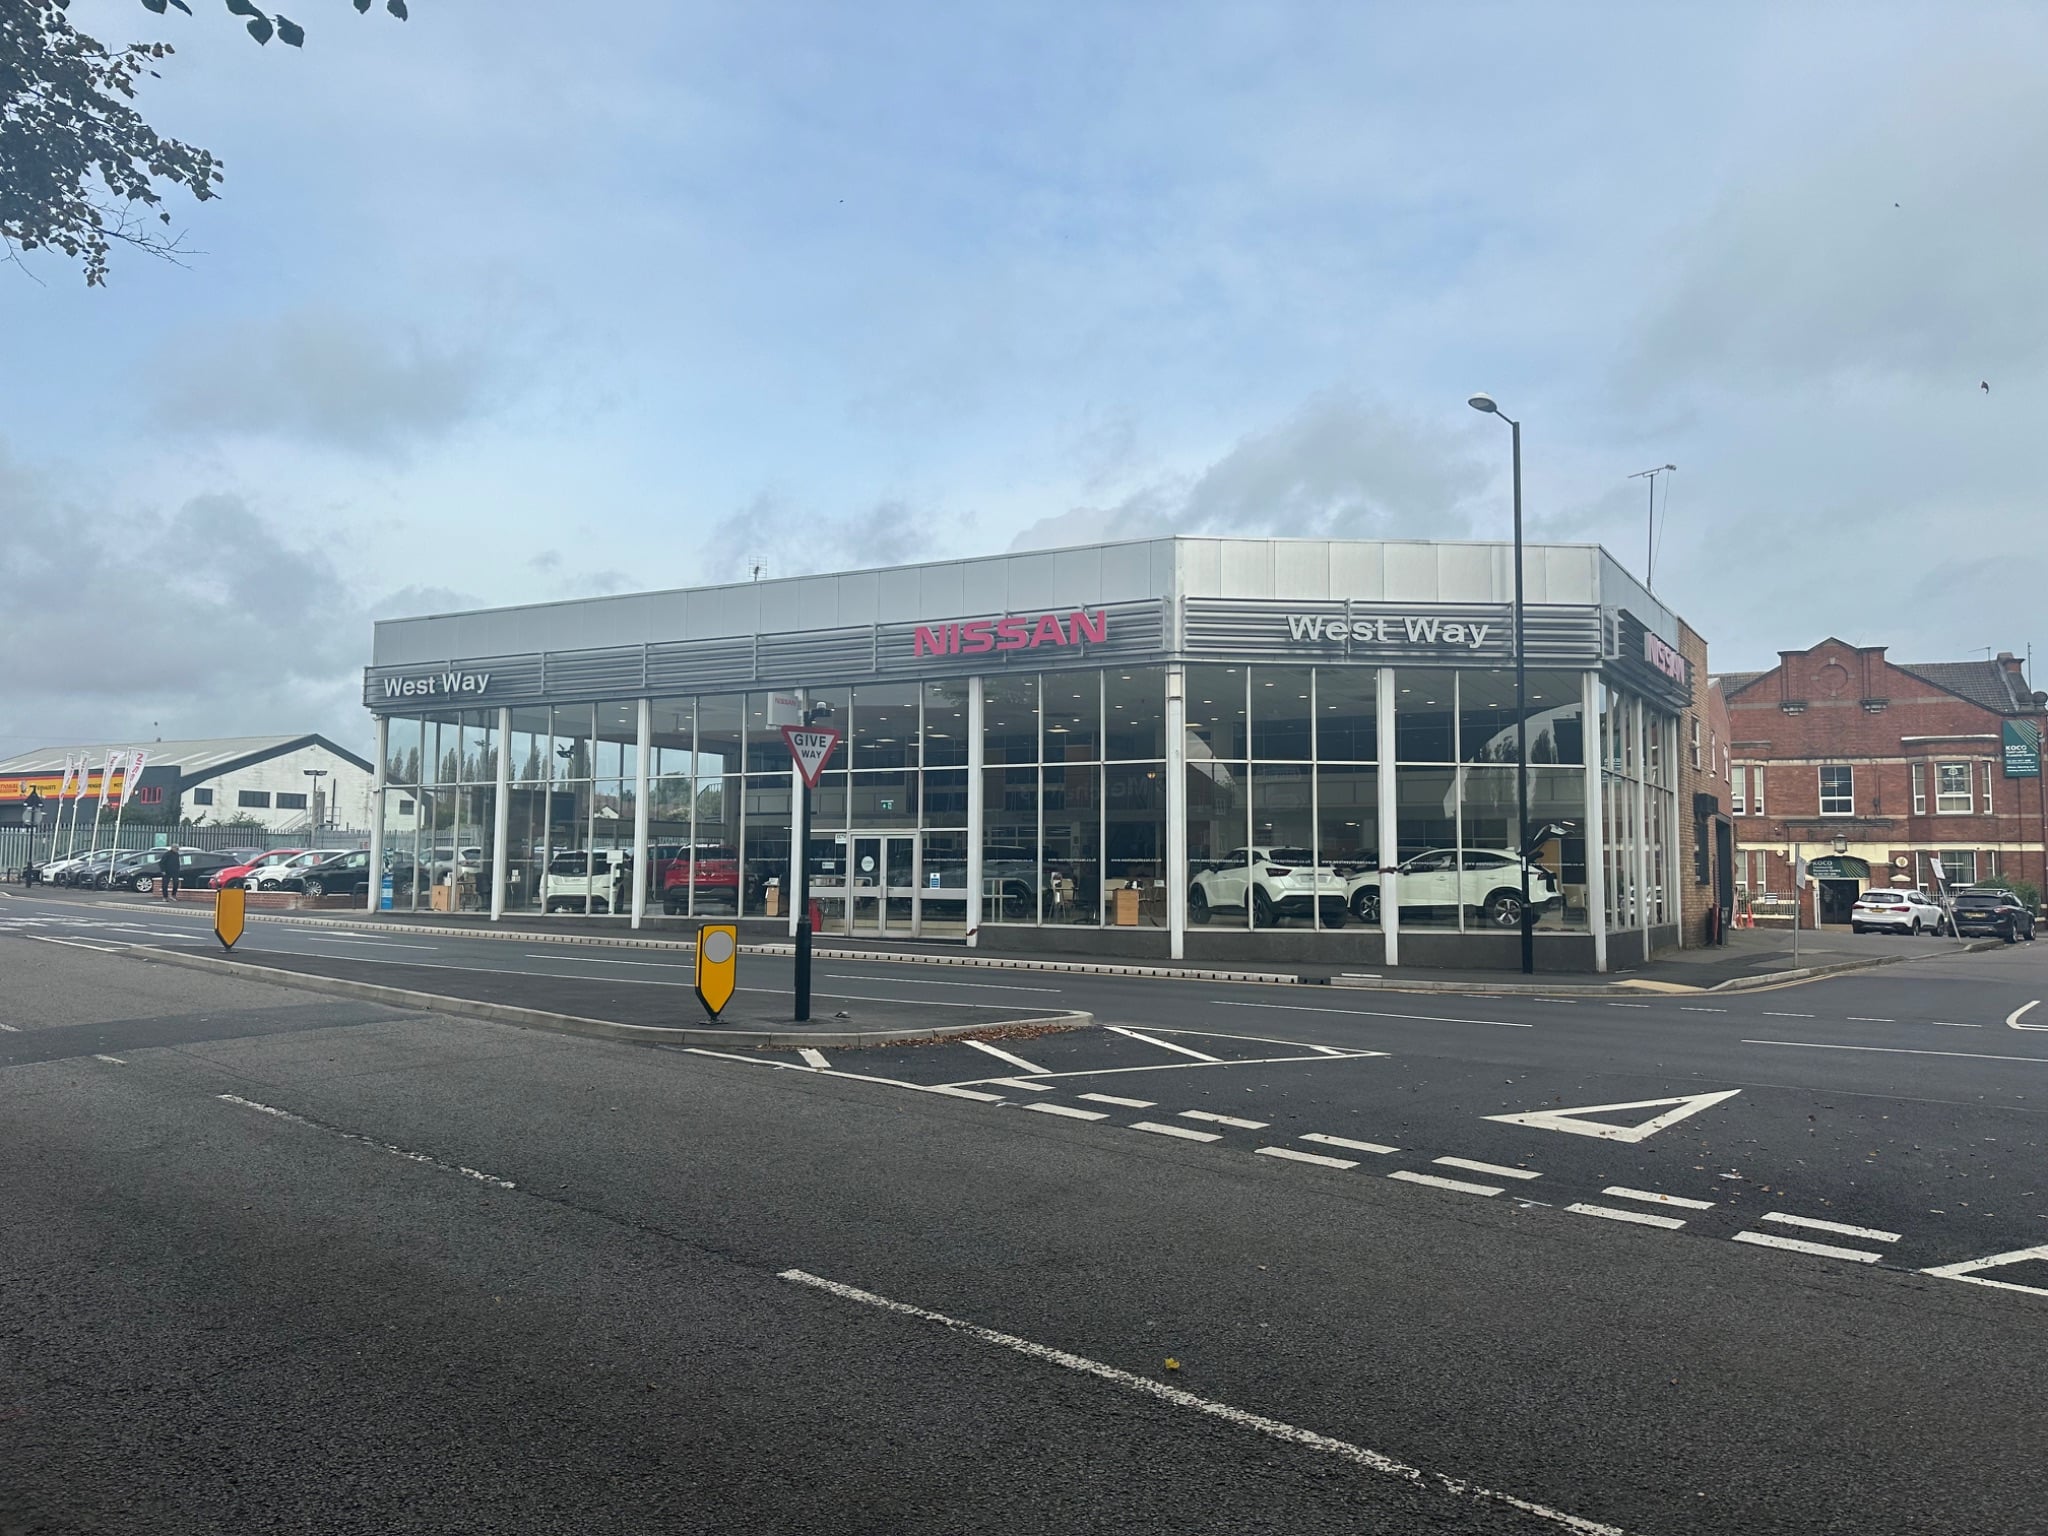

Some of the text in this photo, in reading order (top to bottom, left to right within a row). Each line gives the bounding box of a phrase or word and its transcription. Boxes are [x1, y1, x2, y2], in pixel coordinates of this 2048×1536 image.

[914, 610, 1107, 657] NISSAN
[1286, 615, 1489, 648] West Way
[384, 672, 490, 697] West Way
[794, 734, 827, 748] GIVE
[801, 749, 822, 759] WAY
